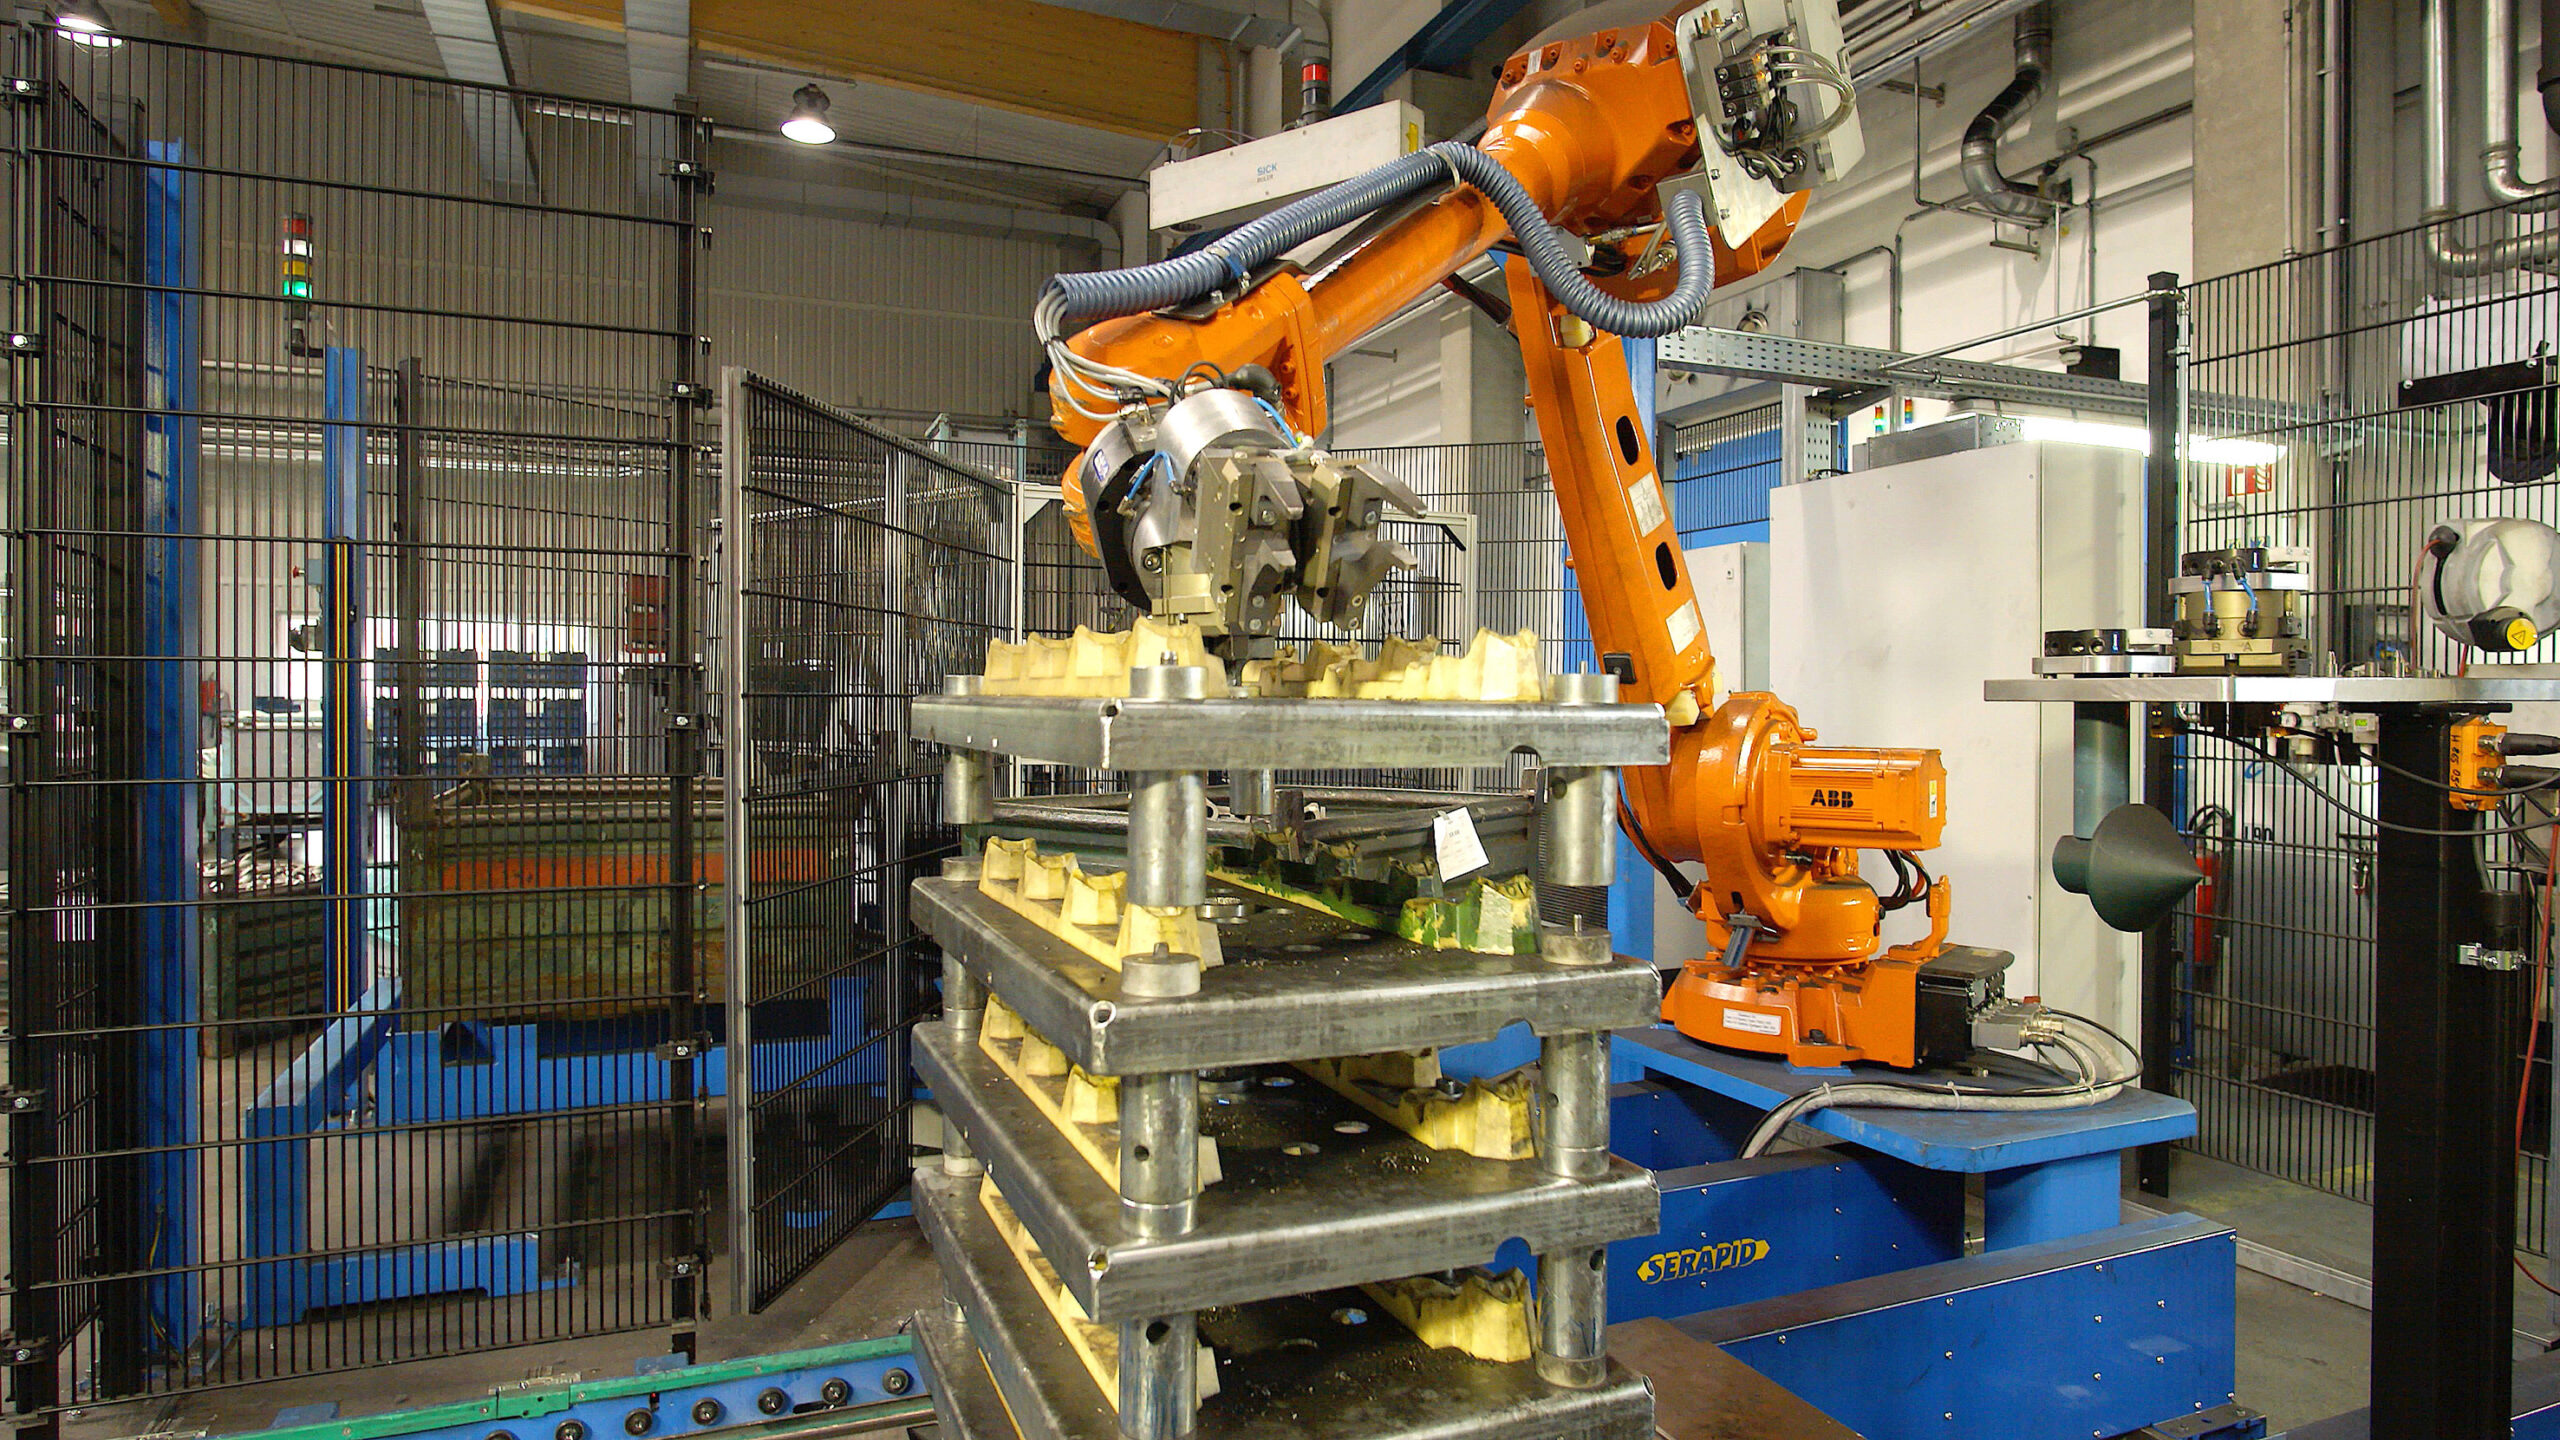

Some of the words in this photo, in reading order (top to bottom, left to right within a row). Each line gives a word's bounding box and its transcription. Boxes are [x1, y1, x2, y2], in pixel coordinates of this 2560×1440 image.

[1256, 162, 1278, 176] SICK
[1810, 788, 1854, 808] ABB
[1645, 1239, 1758, 1284] SERAPID
